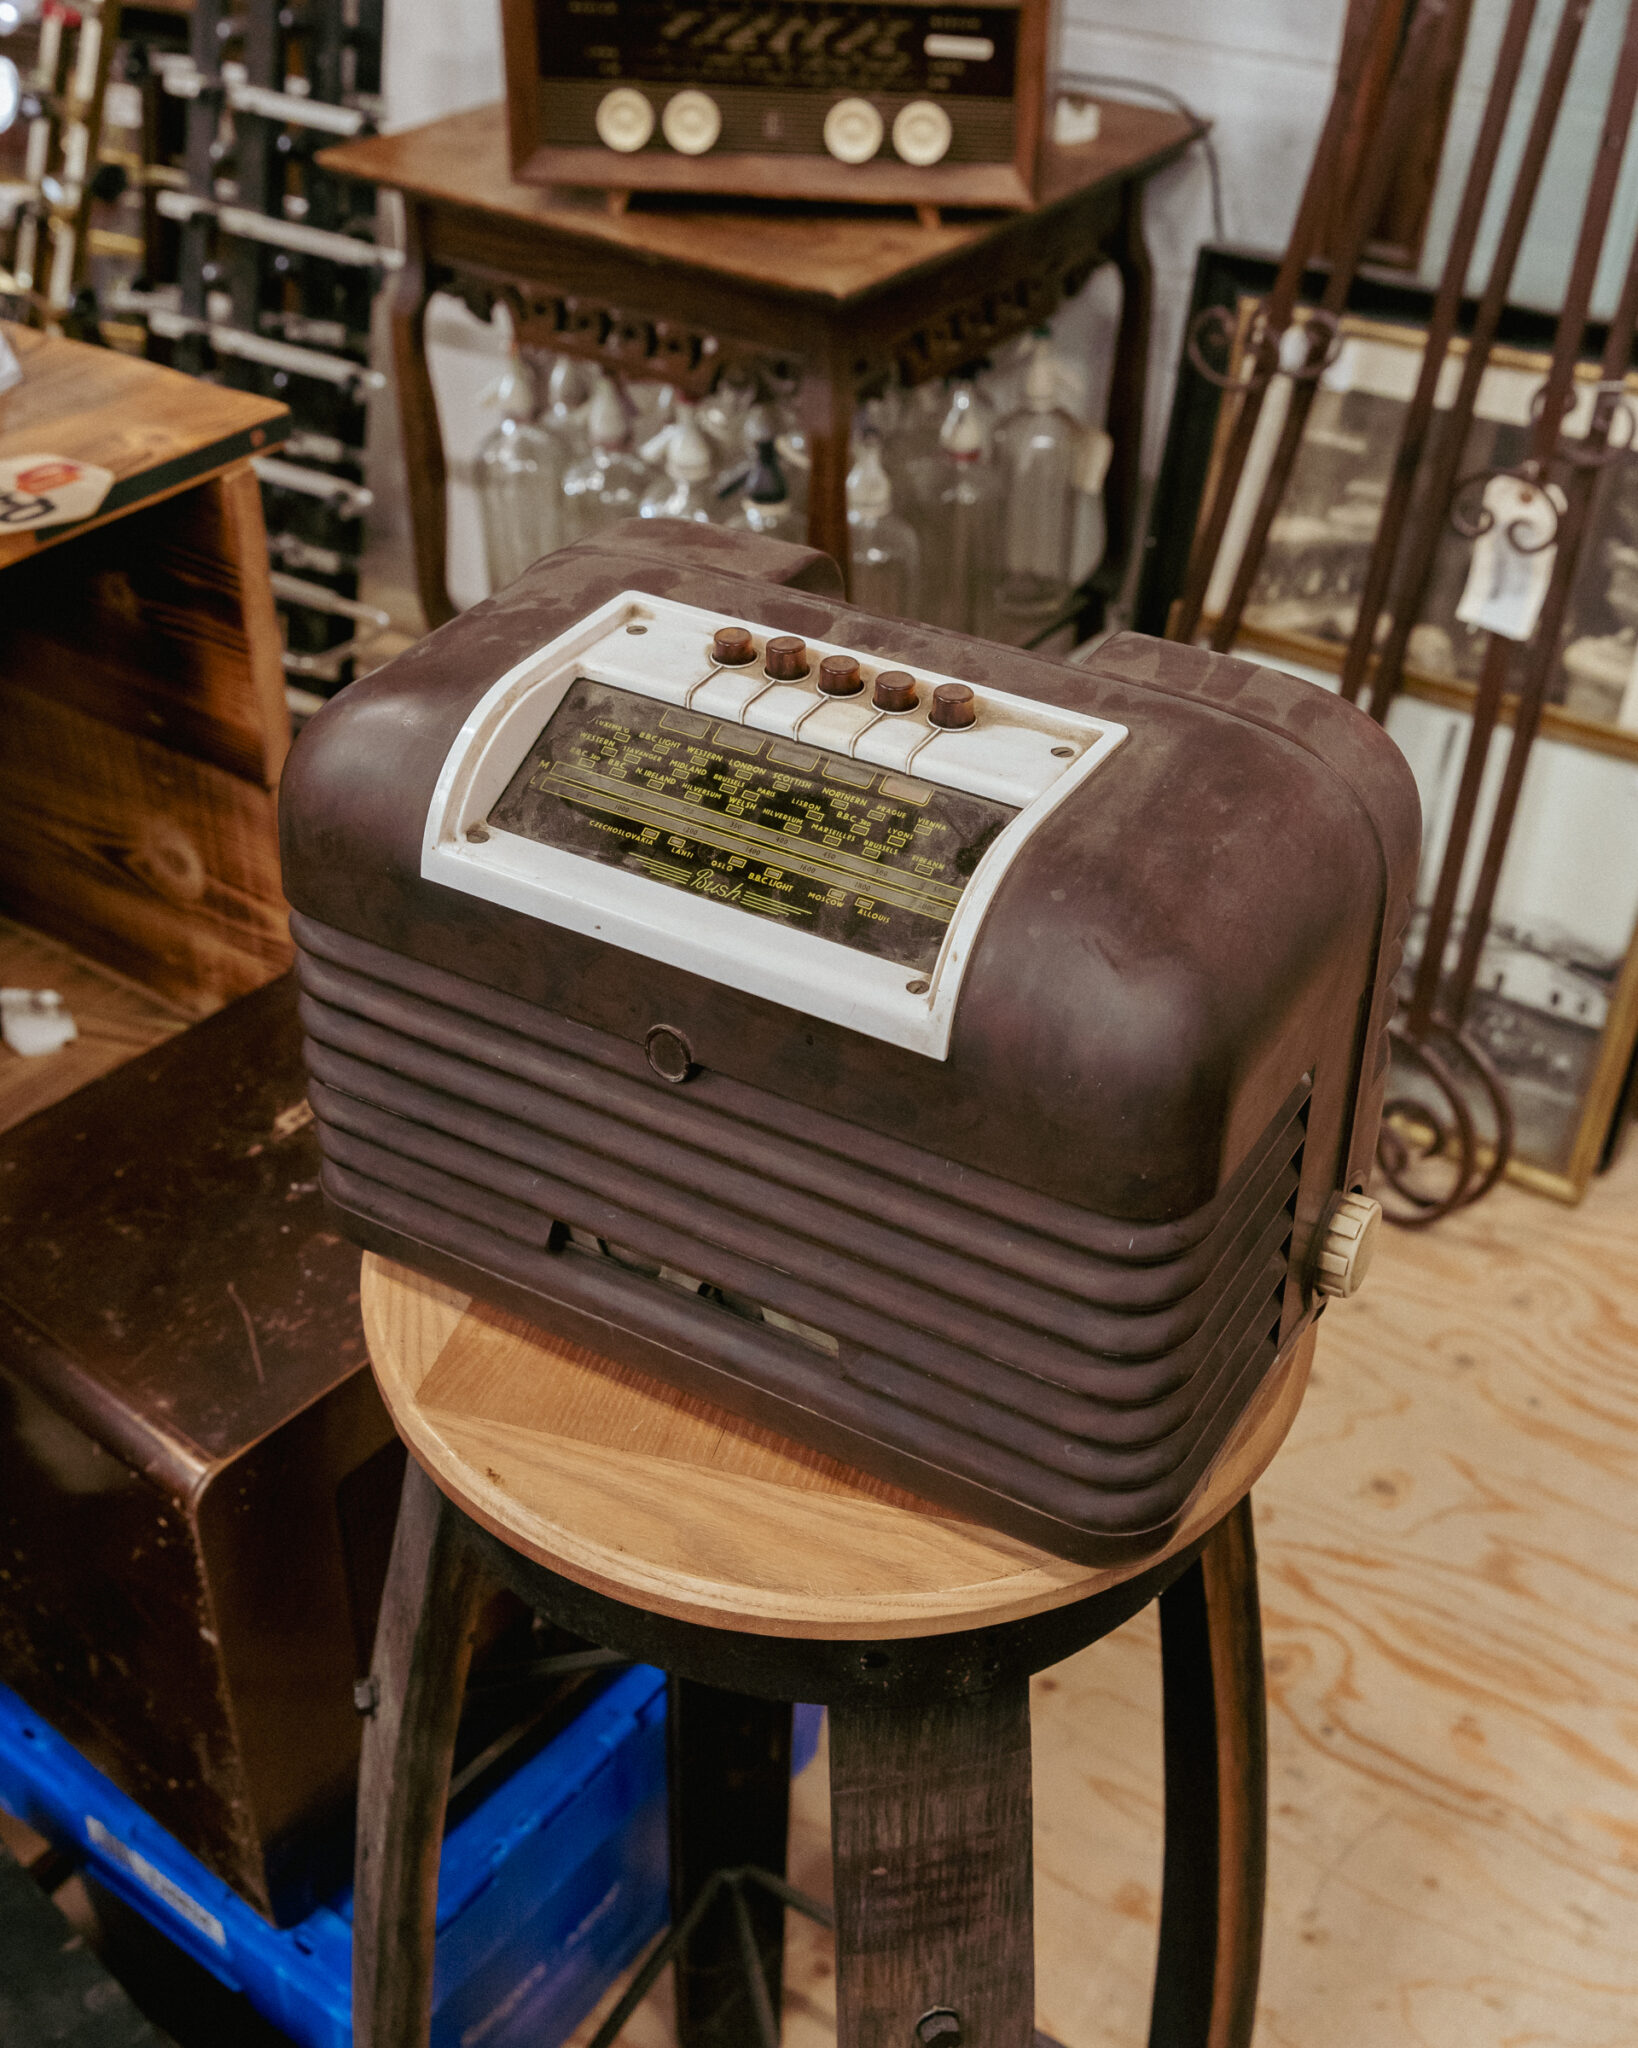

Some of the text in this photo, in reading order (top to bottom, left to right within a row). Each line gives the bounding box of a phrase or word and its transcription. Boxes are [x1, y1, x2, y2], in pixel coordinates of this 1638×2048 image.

[580, 732, 616, 747] WESTERN
[658, 738, 682, 750] LIGHT
[622, 745, 662, 762] STAVANGER
[686, 746, 723, 762] WESTERN
[539, 760, 550, 770] M
[669, 760, 708, 776] MIDLAND
[728, 759, 767, 775] LONDON
[644, 770, 677, 785] IRELAND
[713, 773, 745, 788] BRUSSELS
[772, 772, 813, 789] SCOTTISH
[682, 782, 722, 799] HILVERSUM
[757, 787, 777, 798] PARIS
[822, 787, 868, 807] NORTHERN
[729, 796, 758, 811] WELSH
[791, 798, 822, 812] LISBON
[762, 808, 803, 825] HILVERSUM
[876, 805, 907, 819] PRAGUE
[917, 817, 948, 831] VIENNA
[589, 820, 654, 846] CZECHOSLOVAKIA
[811, 823, 856, 842] MARSEILLES
[887, 827, 914, 840] LYONS
[671, 847, 695, 859] LAHTI
[730, 821, 743, 830] 350
[776, 837, 789, 845] 400
[823, 851, 836, 860] 450
[875, 868, 888, 877] 500
[863, 839, 899, 855] BRUSSELS
[682, 826, 698, 836] 1200
[745, 846, 760, 856] 1400
[800, 864, 816, 874] 1600
[854, 881, 871, 892] 1800
[711, 860, 733, 872] OSLO
[690, 868, 744, 901] Bush
[769, 878, 794, 893] LIGHT
[807, 891, 845, 908] MOSCOW
[857, 908, 891, 924] ALLOUIS
